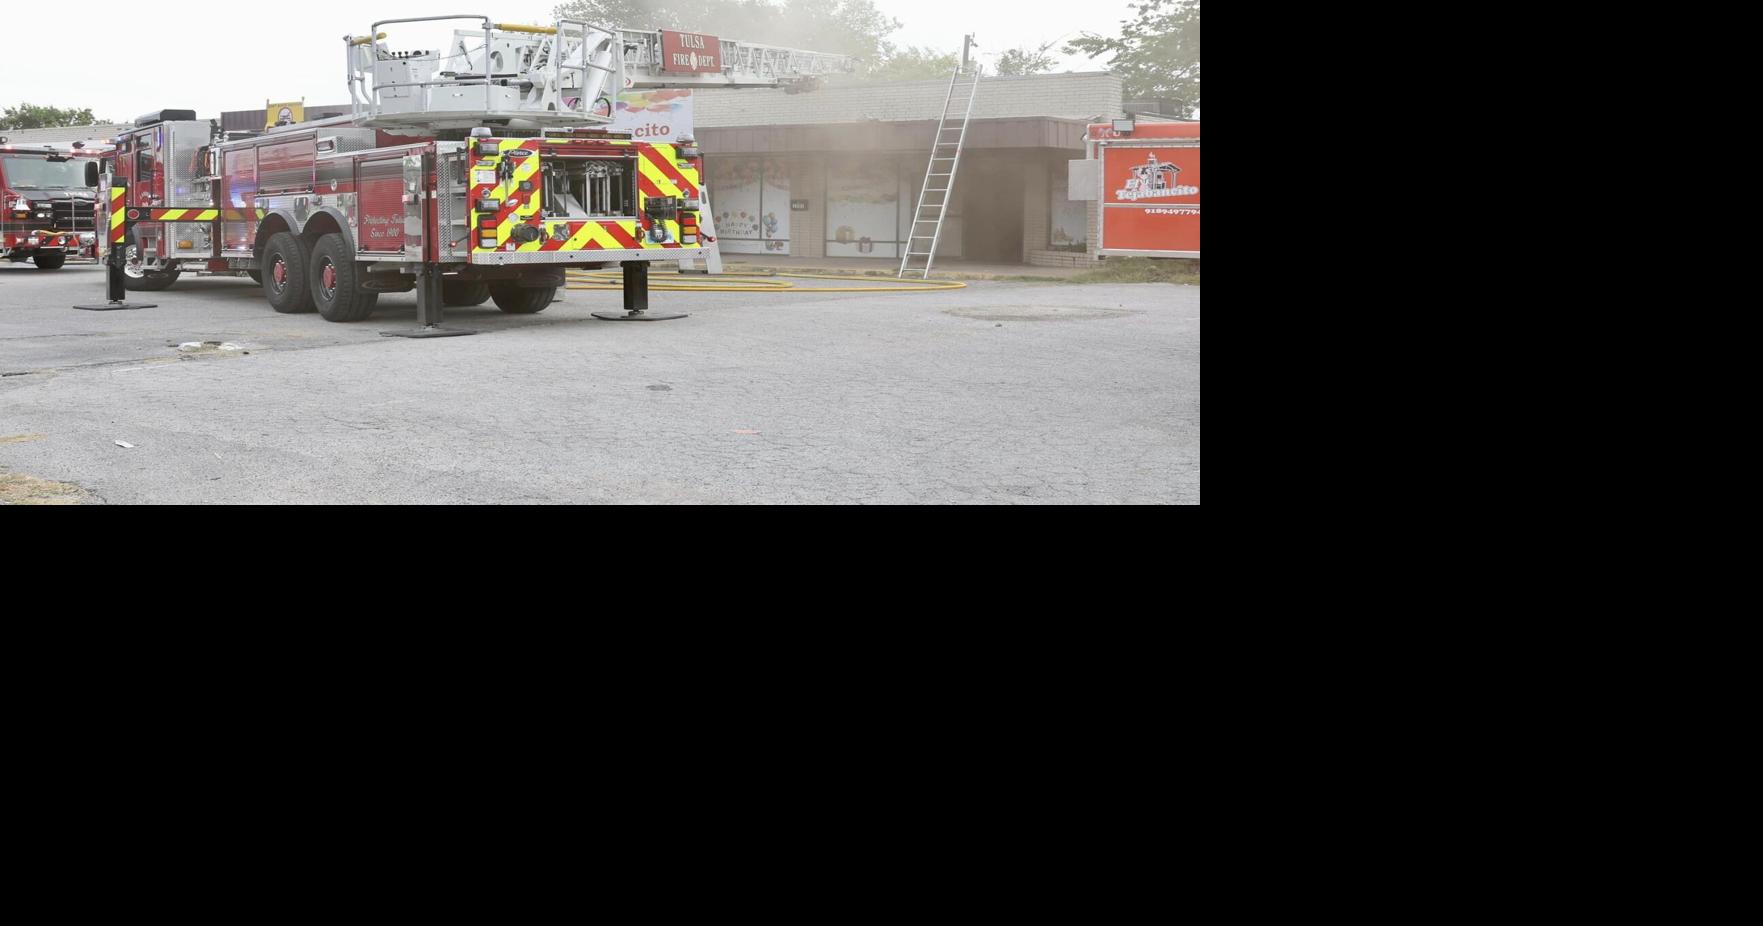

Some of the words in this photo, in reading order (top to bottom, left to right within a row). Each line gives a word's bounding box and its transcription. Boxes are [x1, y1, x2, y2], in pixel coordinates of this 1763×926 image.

[680, 33, 704, 49] TULSA
[672, 53, 690, 66] FIRE
[631, 122, 670, 138] cito
[1115, 185, 1199, 201] Tejabancito
